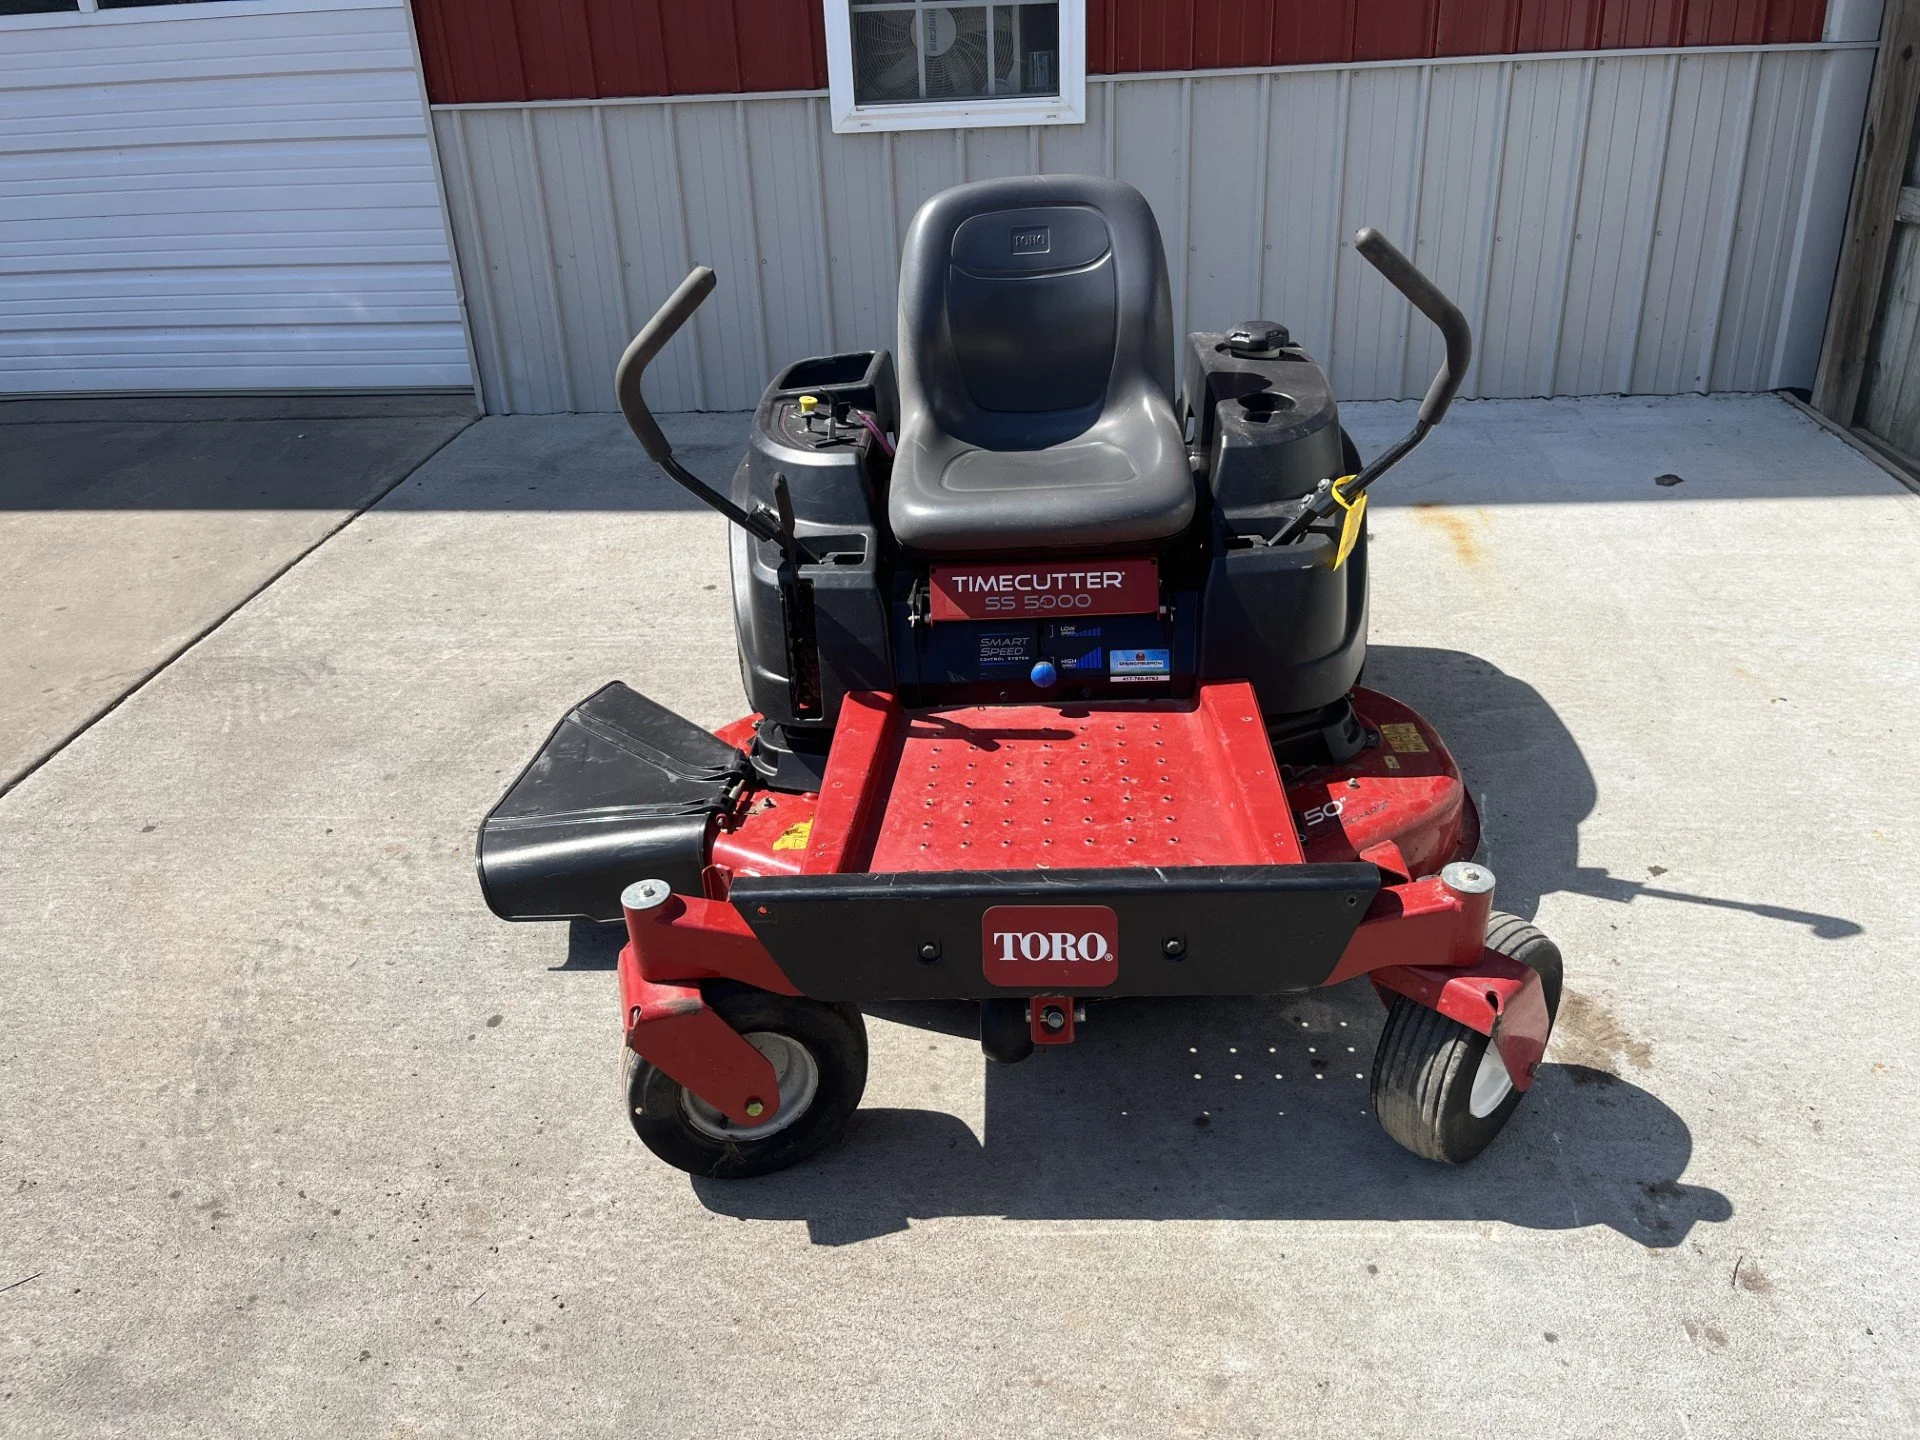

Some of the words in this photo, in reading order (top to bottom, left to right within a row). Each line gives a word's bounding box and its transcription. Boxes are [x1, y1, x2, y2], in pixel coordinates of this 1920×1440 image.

[952, 571, 1124, 592] TIMECUTTER
[985, 595, 1016, 610] SS
[1024, 593, 1092, 610] 5000
[980, 637, 1030, 647] SMART
[980, 647, 1024, 657] SPEED
